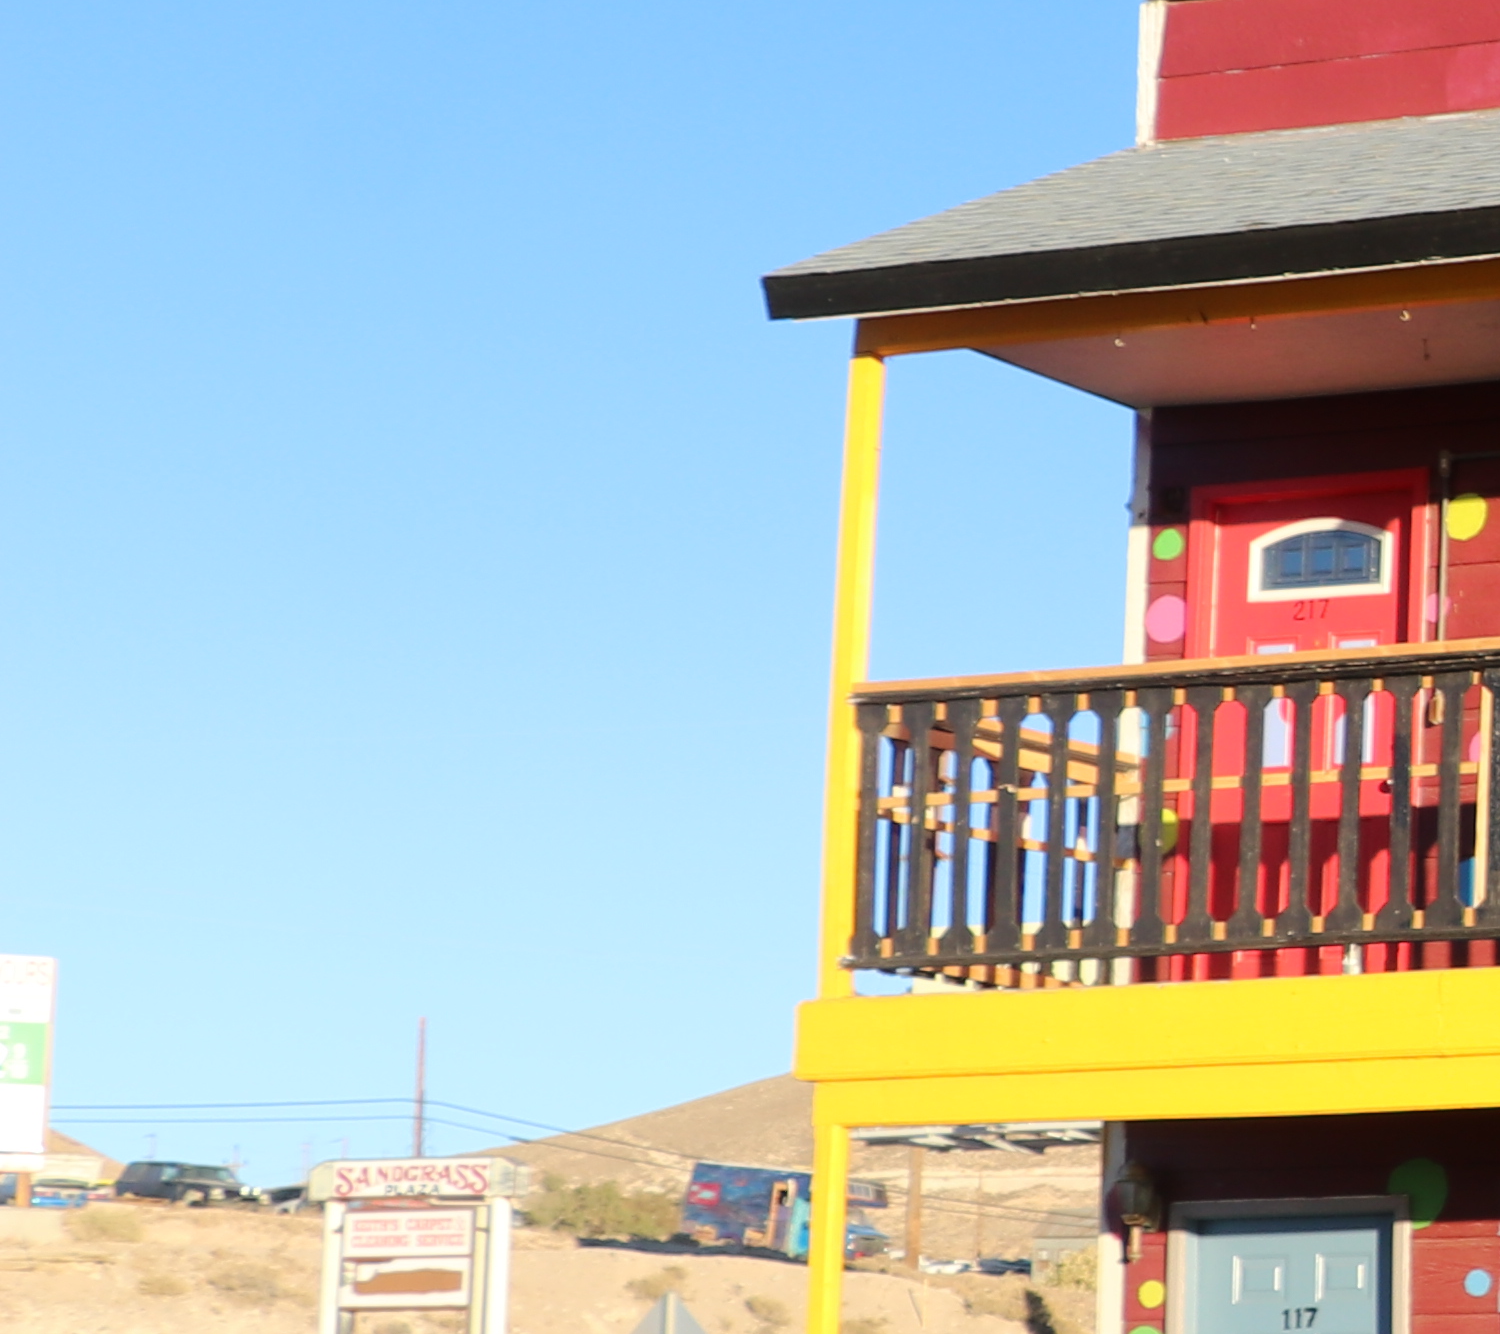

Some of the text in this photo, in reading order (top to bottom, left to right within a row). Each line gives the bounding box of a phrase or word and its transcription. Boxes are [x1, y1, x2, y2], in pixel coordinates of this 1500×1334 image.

[1292, 598, 1330, 621] 217
[334, 1163, 489, 1198] SANDGRASS
[384, 1184, 441, 1195] PLAZA
[1281, 1307, 1319, 1331] 117
